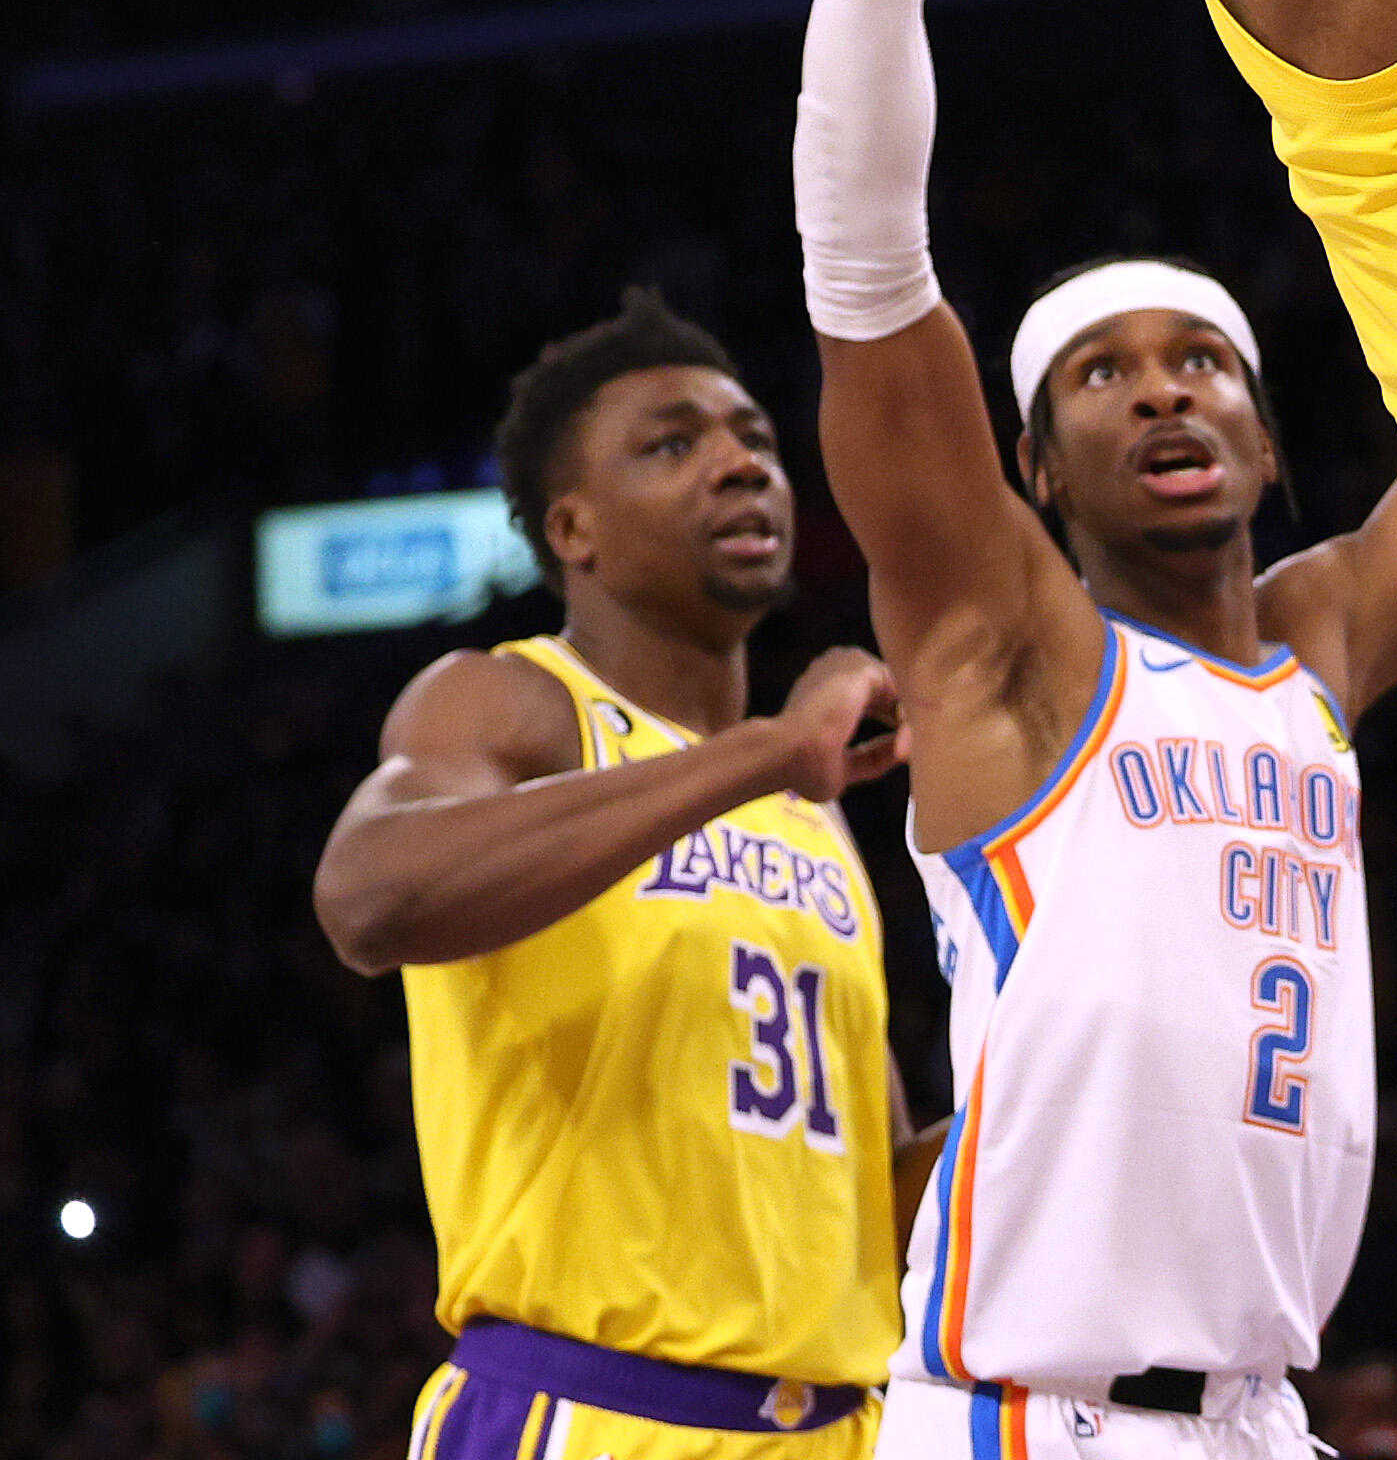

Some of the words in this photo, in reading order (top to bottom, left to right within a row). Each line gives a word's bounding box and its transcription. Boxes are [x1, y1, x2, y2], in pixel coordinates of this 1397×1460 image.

[635, 823, 860, 940] LAKERS
[1220, 841, 1341, 952] CITY
[728, 940, 845, 1155] 31
[1243, 954, 1316, 1137] 2
